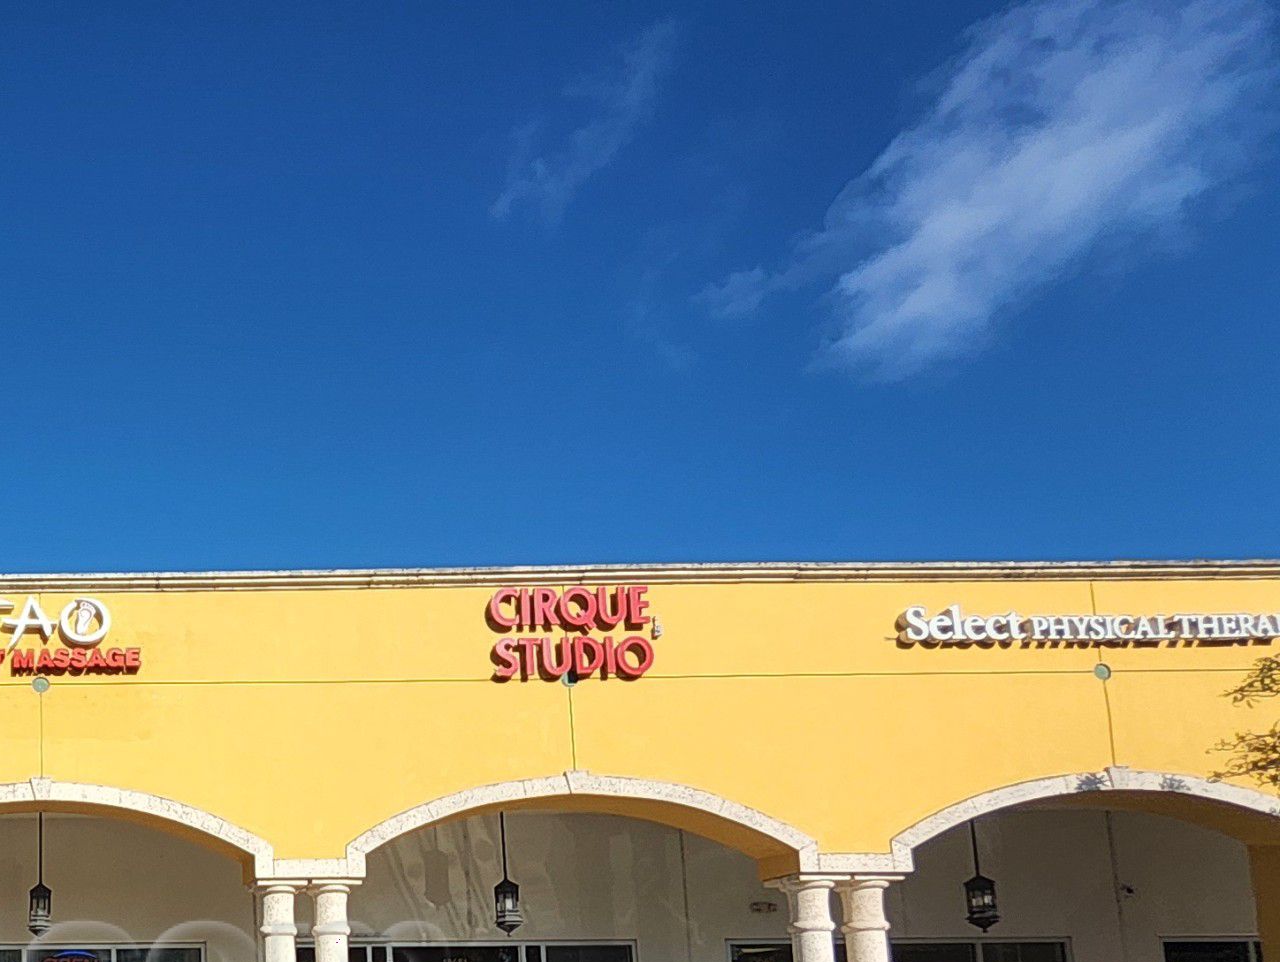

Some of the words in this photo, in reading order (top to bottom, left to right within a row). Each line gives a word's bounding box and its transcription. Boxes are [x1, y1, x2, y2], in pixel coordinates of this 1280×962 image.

[490, 586, 651, 628] CIRQUE
[904, 594, 1027, 641] Select
[1031, 614, 1175, 640] PHYSICAL
[1173, 613, 1280, 639] THERA
[12, 647, 141, 669] MASSAGE
[495, 636, 654, 676] STUDIO
